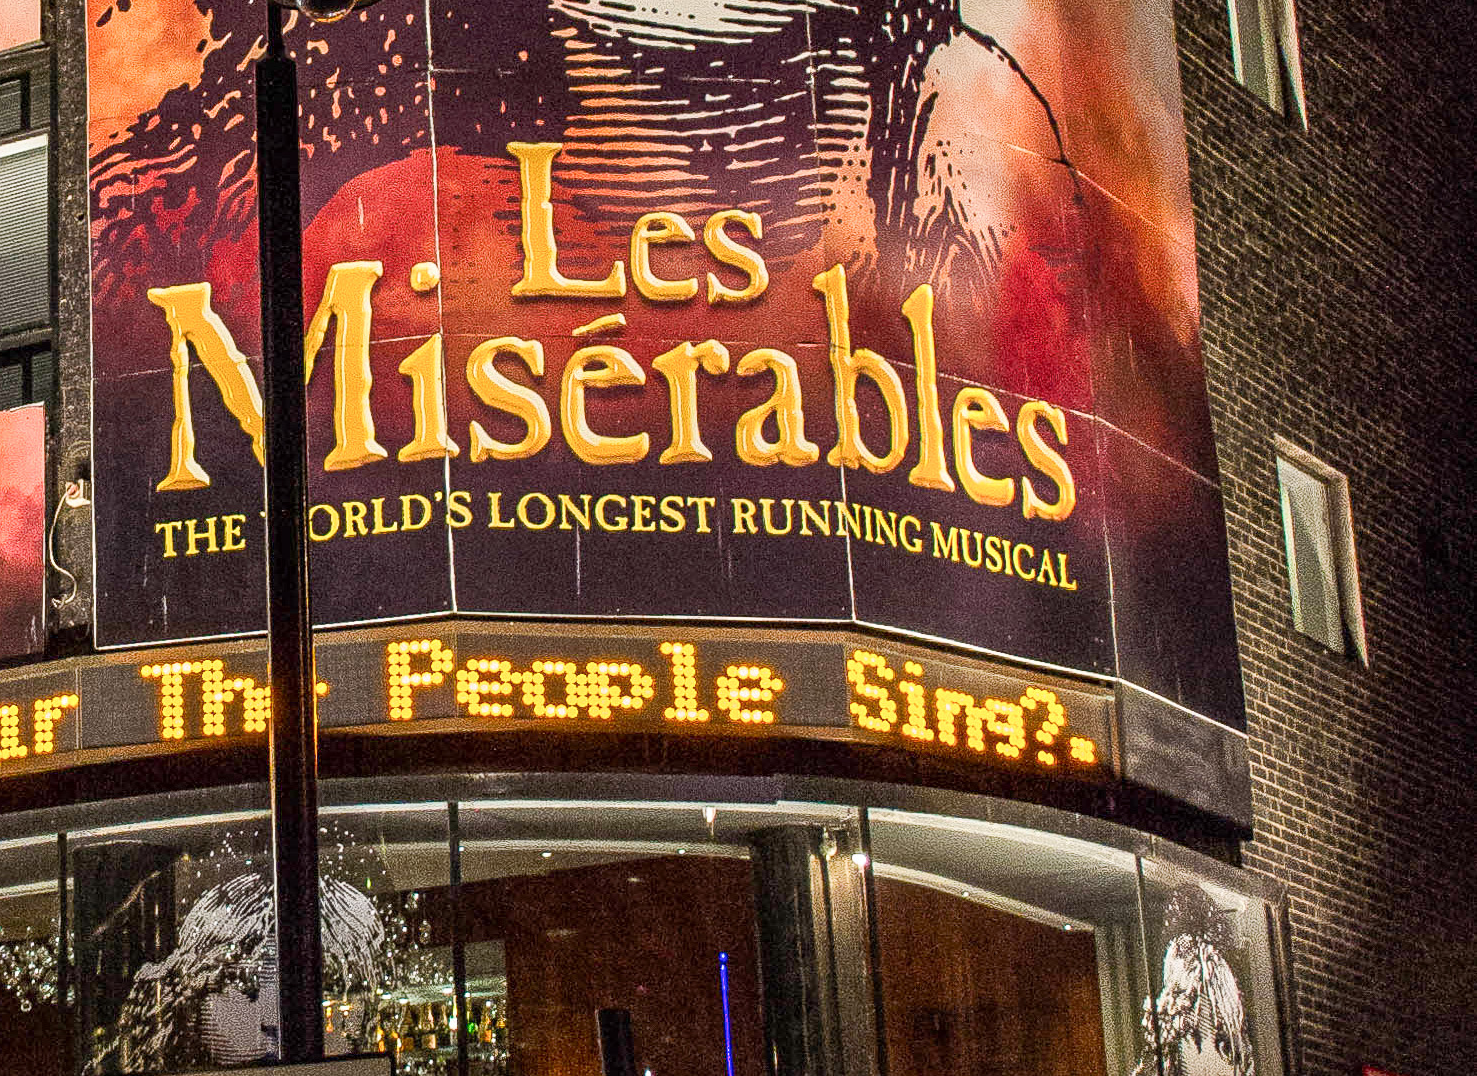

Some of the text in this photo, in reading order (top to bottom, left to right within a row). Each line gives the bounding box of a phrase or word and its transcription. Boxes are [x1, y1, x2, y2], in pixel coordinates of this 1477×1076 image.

[505, 140, 770, 303] Les
[147, 260, 1077, 522] Misérables
[155, 490, 1078, 591] THE ORLD'S LONGEST RUNNING MUSICAL
[140, 659, 328, 740] Th
[387, 639, 785, 724] People
